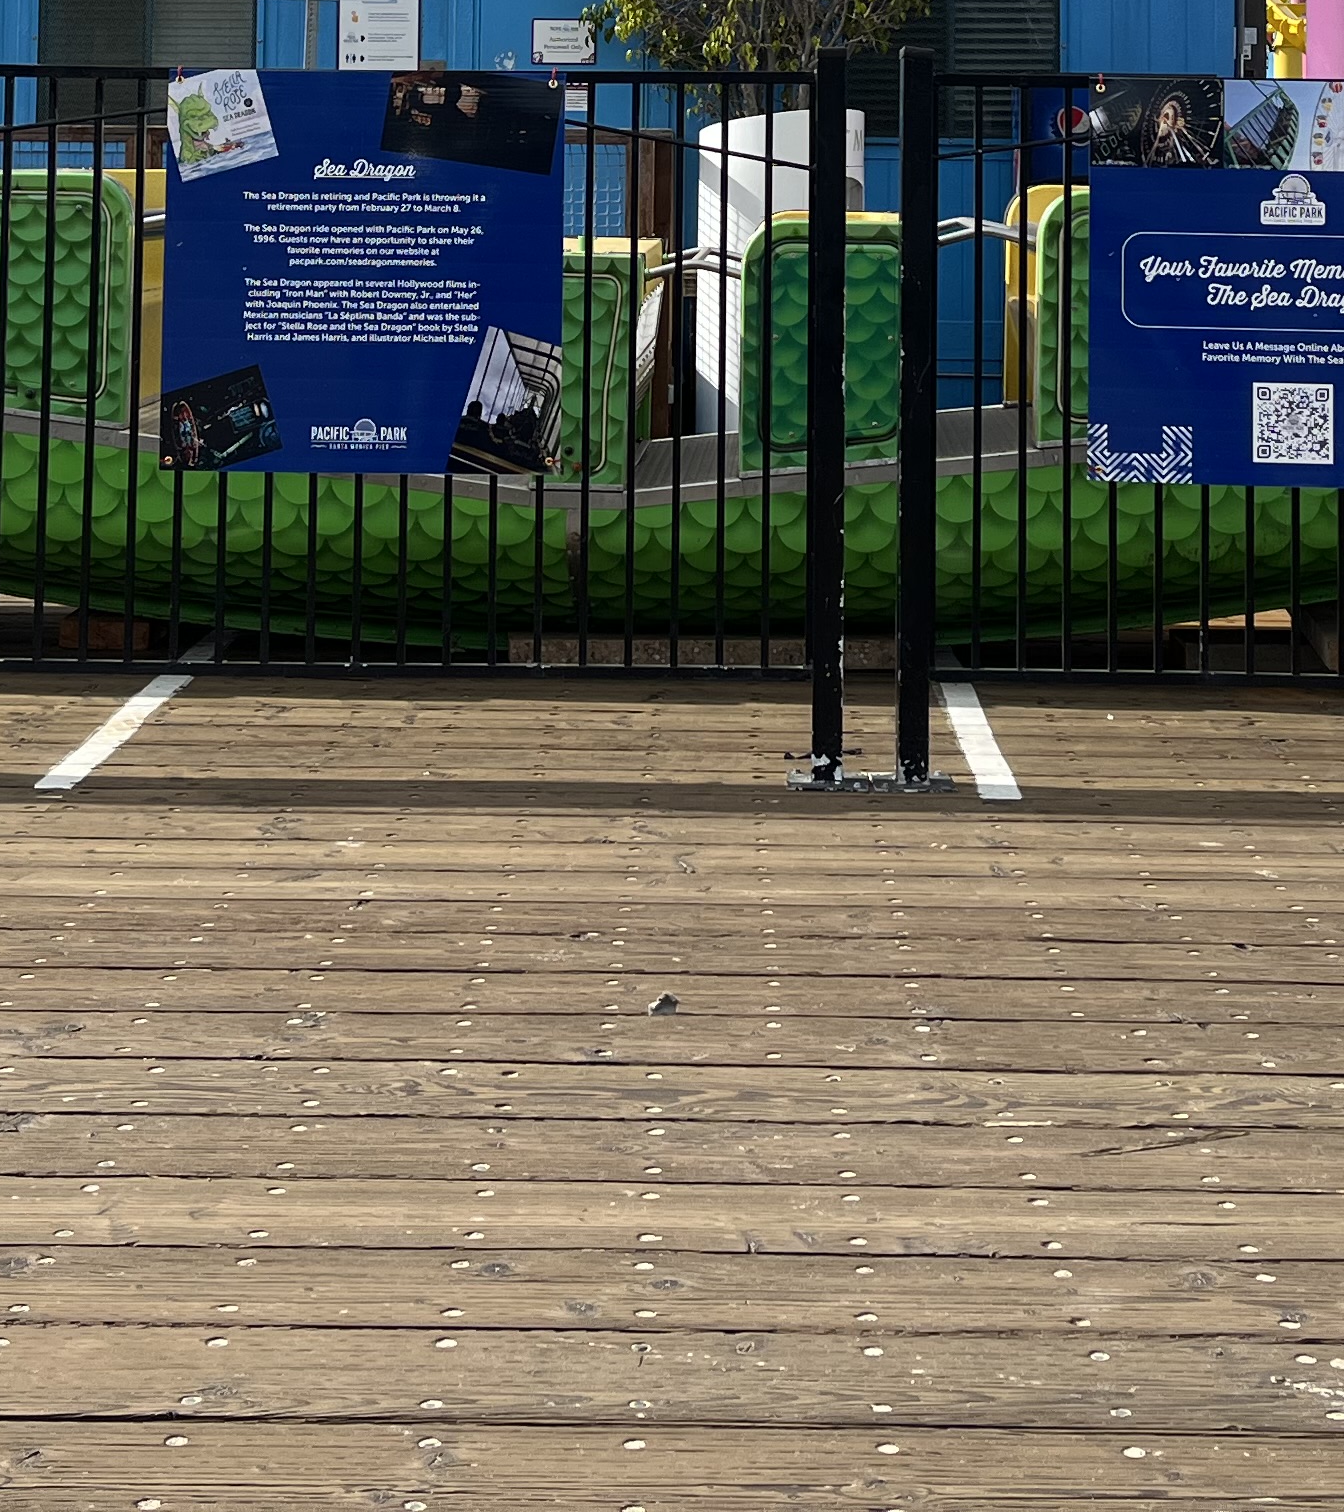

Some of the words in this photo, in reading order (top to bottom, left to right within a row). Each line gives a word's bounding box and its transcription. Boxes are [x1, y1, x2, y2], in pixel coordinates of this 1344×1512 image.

[313, 158, 348, 180] Sea
[349, 158, 416, 182] Dragon
[243, 191, 260, 200] The
[261, 192, 277, 200] Sea
[278, 192, 311, 202] Dragon
[311, 192, 319, 200] is
[320, 193, 353, 202] retiring
[353, 193, 371, 201] and
[371, 193, 401, 201] Pacific
[402, 193, 422, 201] Park
[422, 193, 430, 201] is
[431, 194, 471, 204] throwing
[472, 194, 479, 202] it
[267, 203, 313, 211] retirement
[314, 204, 337, 213] party
[338, 203, 360, 211] from
[361, 203, 399, 213] February
[400, 204, 412, 212] 27
[412, 205, 423, 213] to
[424, 204, 452, 213] March
[1263, 206, 1298, 218] PACIFIC
[1300, 207, 1323, 219] PARK
[244, 224, 261, 232] The
[262, 224, 278, 232] Sea
[279, 224, 312, 234] Dragon
[312, 225, 330, 233] ride
[331, 225, 364, 234] opened
[365, 225, 385, 233] with
[386, 225, 415, 234] Pacific
[416, 226, 436, 234] Park
[450, 226, 469, 236] May
[253, 235, 277, 243] 1996.
[278, 235, 308, 243] Guests
[330, 236, 351, 244] have
[364, 237, 416, 246] opportunity
[417, 237, 428, 245] to
[428, 237, 453, 245] share
[453, 237, 475, 245] their
[287, 246, 321, 254] favorite
[321, 247, 365, 255] memories
[395, 248, 430, 256] website
[430, 248, 440, 256] at
[1139, 255, 1196, 282] Your
[1198, 255, 1287, 280] Favorite
[244, 278, 262, 286] The
[262, 278, 278, 287] Sea
[280, 278, 312, 289] Dragon
[313, 280, 354, 288] appeared
[355, 279, 364, 287] in
[365, 280, 396, 288] several
[397, 280, 444, 289] Hollywood
[445, 280, 467, 288] films
[1207, 283, 1249, 306] The
[1250, 284, 1293, 311] Sea
[1203, 341, 1230, 350] Leave
[1232, 341, 1245, 351] Us
[1246, 342, 1254, 350] A
[1255, 342, 1296, 353] Message
[1297, 343, 1329, 352] Online
[1202, 353, 1240, 362] Favorite
[1242, 354, 1282, 365] Memory
[1282, 355, 1306, 364] With
[1307, 355, 1326, 364] The
[1327, 355, 1344, 365] Sea
[310, 426, 350, 441] PACIFIC
[380, 427, 407, 441] PARK
